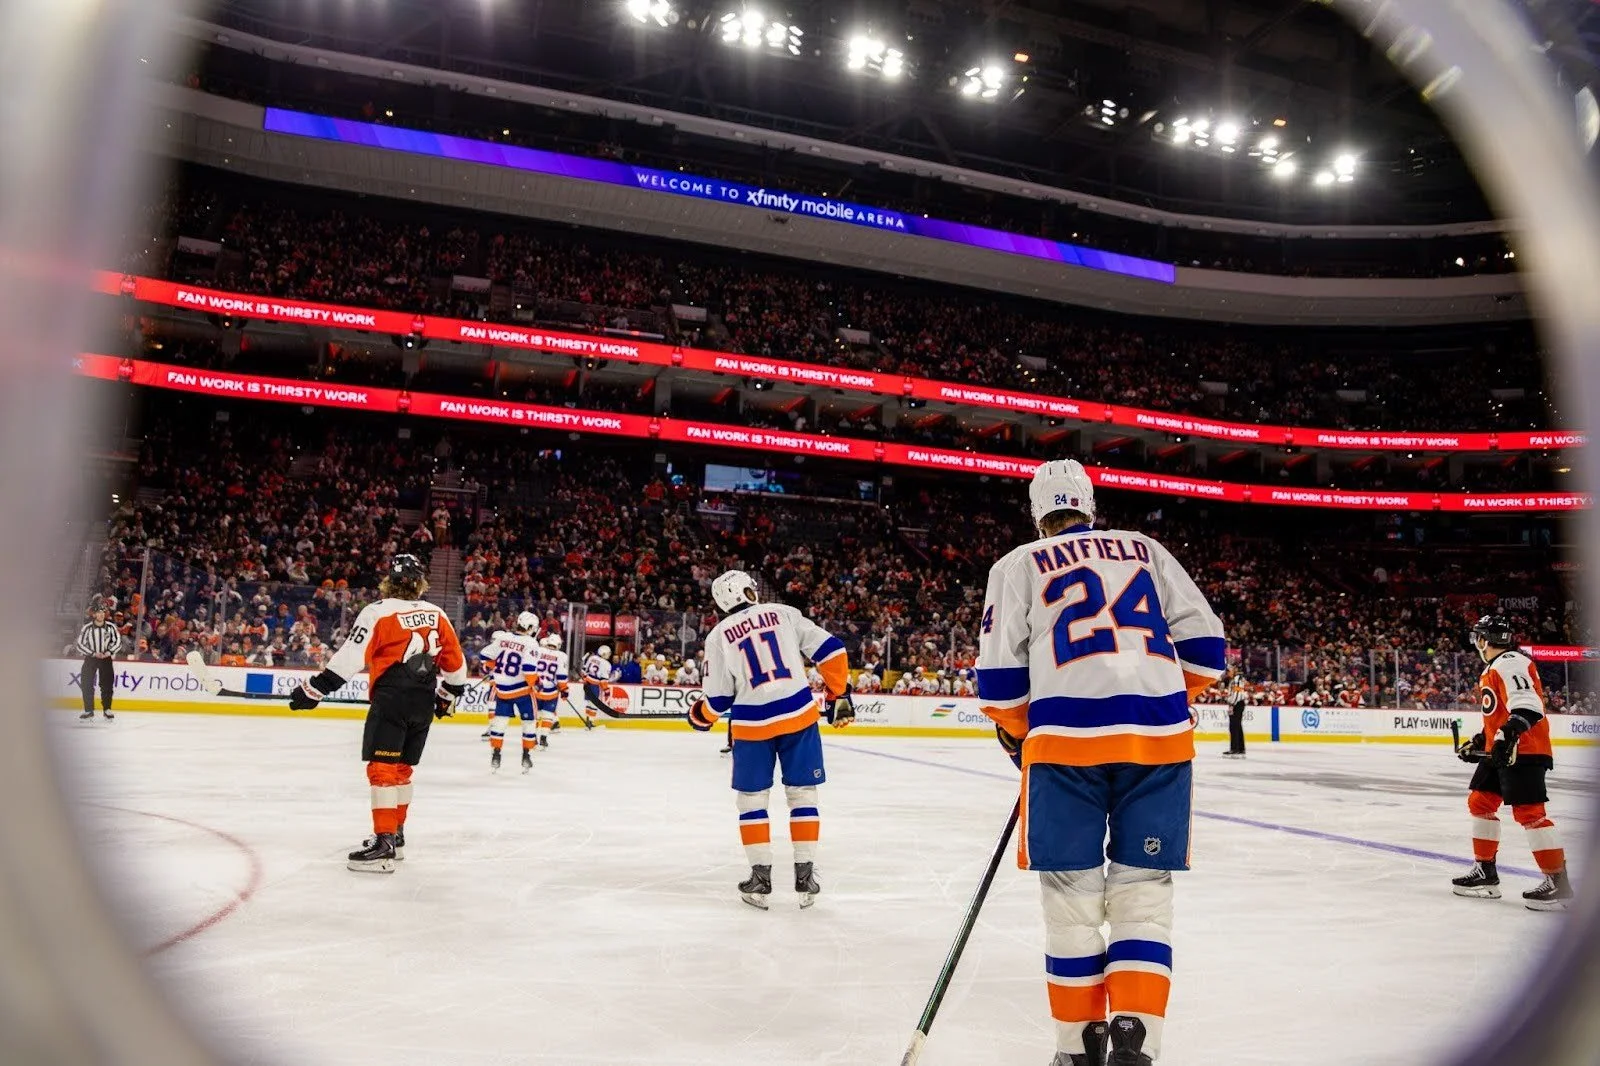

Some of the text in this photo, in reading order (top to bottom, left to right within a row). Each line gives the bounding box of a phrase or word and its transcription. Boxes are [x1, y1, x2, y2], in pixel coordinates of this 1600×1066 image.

[636, 172, 905, 229] WELCOME TO xfinity mobile ARENA
[177, 290, 375, 326] FAN WORK IS THIRSTY WORK
[460, 326, 639, 358] FAN WORK IS THIRSTY WORK
[714, 357, 875, 387] FAN WORK IS THIRSTY WORK
[167, 371, 367, 404] FAN WORK IS THIRSTY WORK
[940, 387, 1080, 414] FAN WORK IS THIRSTY WORK
[440, 401, 621, 429] FAN WORK IS THIRSTY WORK
[1136, 413, 1259, 438] FAN WORK IS THIRSTY WORK
[686, 426, 850, 453] FAN WORK IS THIRSTY WORK
[1317, 434, 1459, 447] FAN WORK IS THIRSTY WORK
[1529, 436, 1553, 445] FAN
[907, 450, 929, 462] FAN
[929, 453, 963, 466] WORK
[964, 458, 976, 467] IS
[975, 458, 1019, 473] THIRSTY
[1100, 472, 1224, 496] FAN WORK IS THIRSTY WORK
[1272, 490, 1409, 505] FAN WORK IS THIRSTY WORK
[1054, 493, 1068, 506] 24
[1463, 498, 1485, 507] FAN
[1486, 498, 1523, 507] WORK
[1524, 498, 1536, 506] IS
[1537, 497, 1586, 506] THIRSTY
[1031, 537, 1151, 575] MAYFIELD
[723, 611, 781, 645] DUCLAIR
[1041, 565, 1178, 670] 24
[494, 650, 523, 678] 48
[738, 630, 794, 690] 11
[1532, 650, 1580, 658] HIGHLANDER
[1512, 674, 1530, 690] 11
[1394, 716, 1419, 729] PLAY
[1420, 719, 1429, 728] TO
